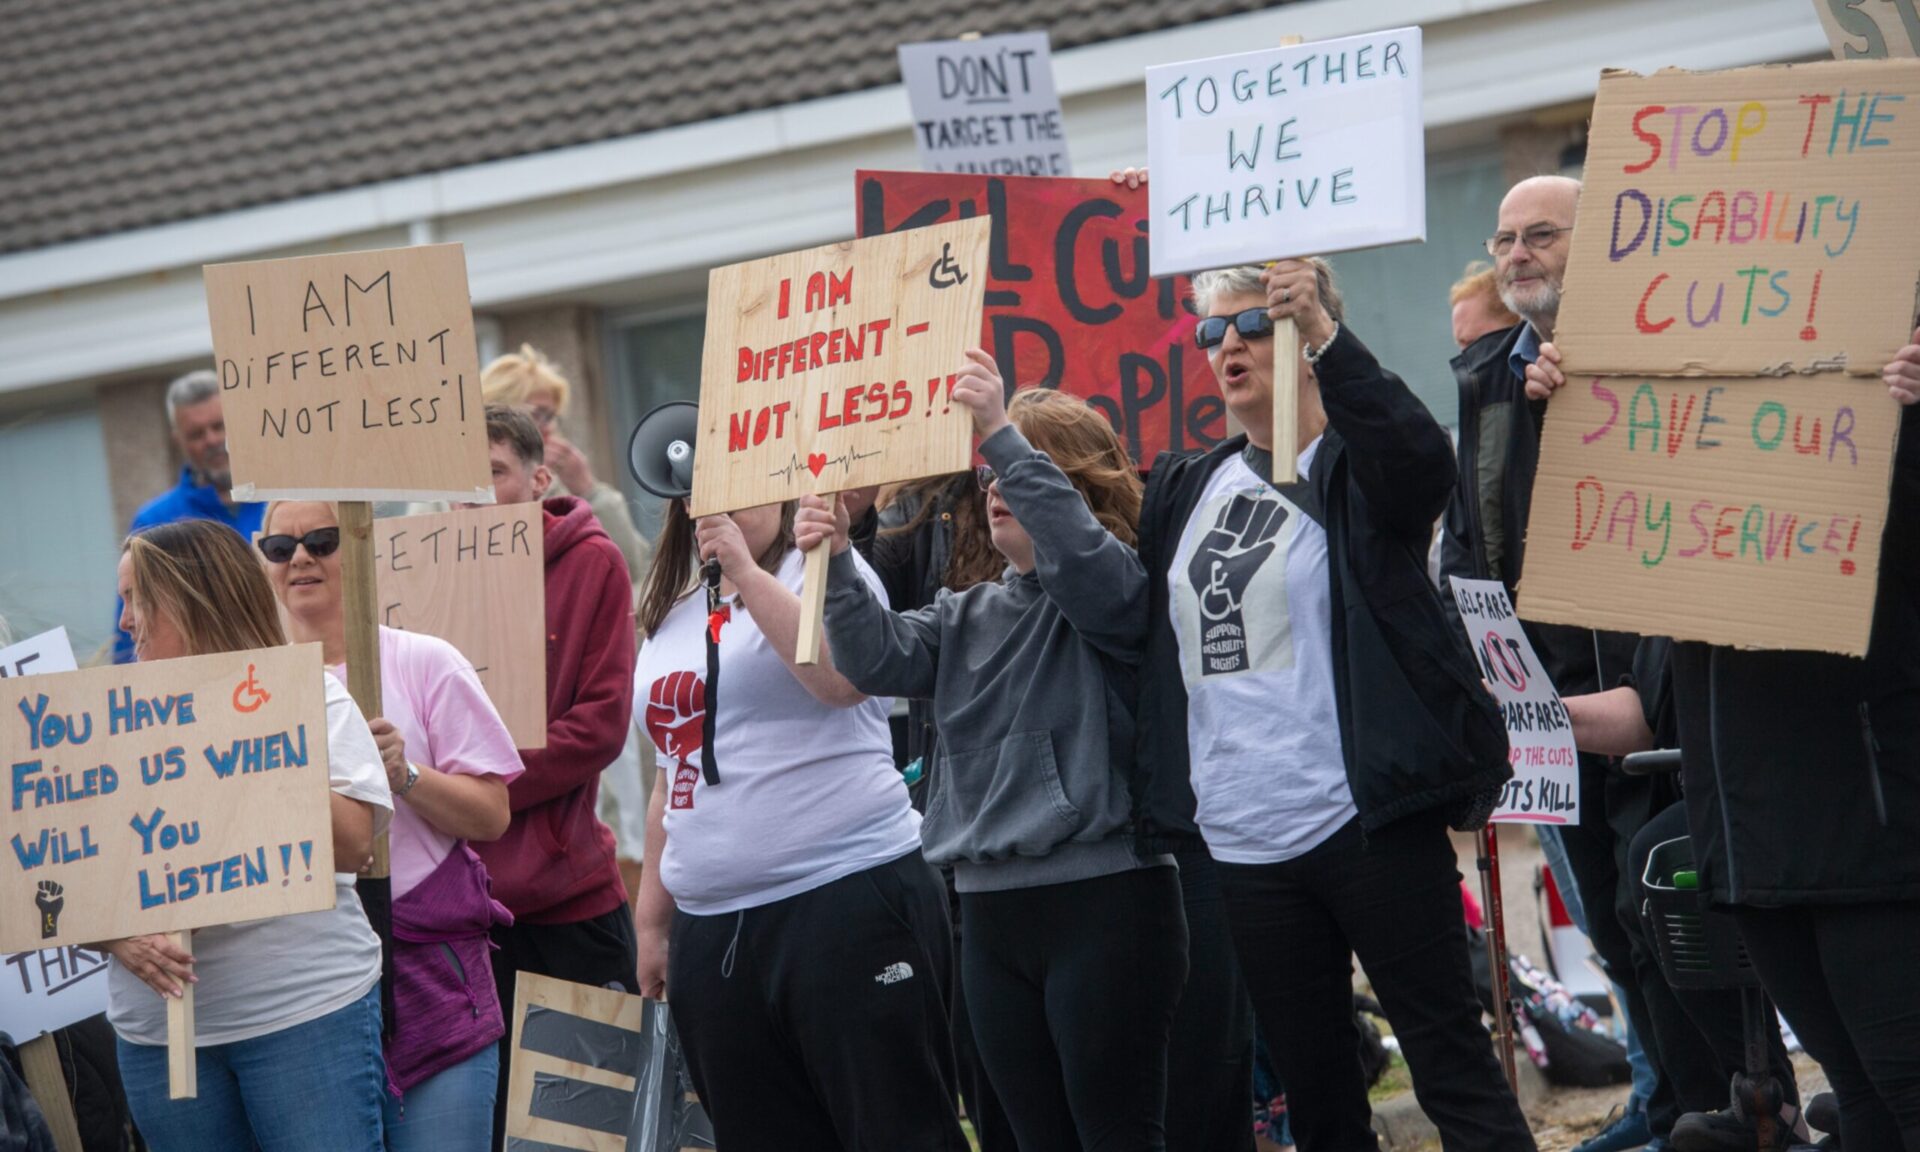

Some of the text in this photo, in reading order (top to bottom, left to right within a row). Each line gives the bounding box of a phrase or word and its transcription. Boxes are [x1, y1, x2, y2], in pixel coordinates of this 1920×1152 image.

[937, 48, 1035, 99] DON'T
[1161, 42, 1406, 118] TOGETHER
[918, 110, 1062, 149] TARGET THE
[1228, 118, 1302, 169] WE
[1623, 90, 1905, 173] STOP THE
[1609, 188, 1859, 261] DISABILITY
[247, 270, 395, 335] I AM
[777, 266, 854, 320] I AM
[1635, 264, 1822, 340] CUTS!
[737, 318, 891, 383] DIFFERENT
[261, 400, 341, 438] NOT
[728, 401, 791, 453] NOT
[1583, 376, 1857, 466] SAVE OUR
[1571, 475, 1861, 576] DAY SERVICE!
[1455, 588, 1512, 621] WELFARE
[1203, 639, 1245, 654] DISABILITY
[1205, 622, 1241, 642] SUPPORT
[1210, 653, 1240, 671] RIGHTS
[140, 746, 187, 785] US
[203, 723, 309, 779] WHEN
[1525, 746, 1545, 766] THE
[1548, 747, 1574, 767] CUTS
[1538, 776, 1575, 813] KILL
